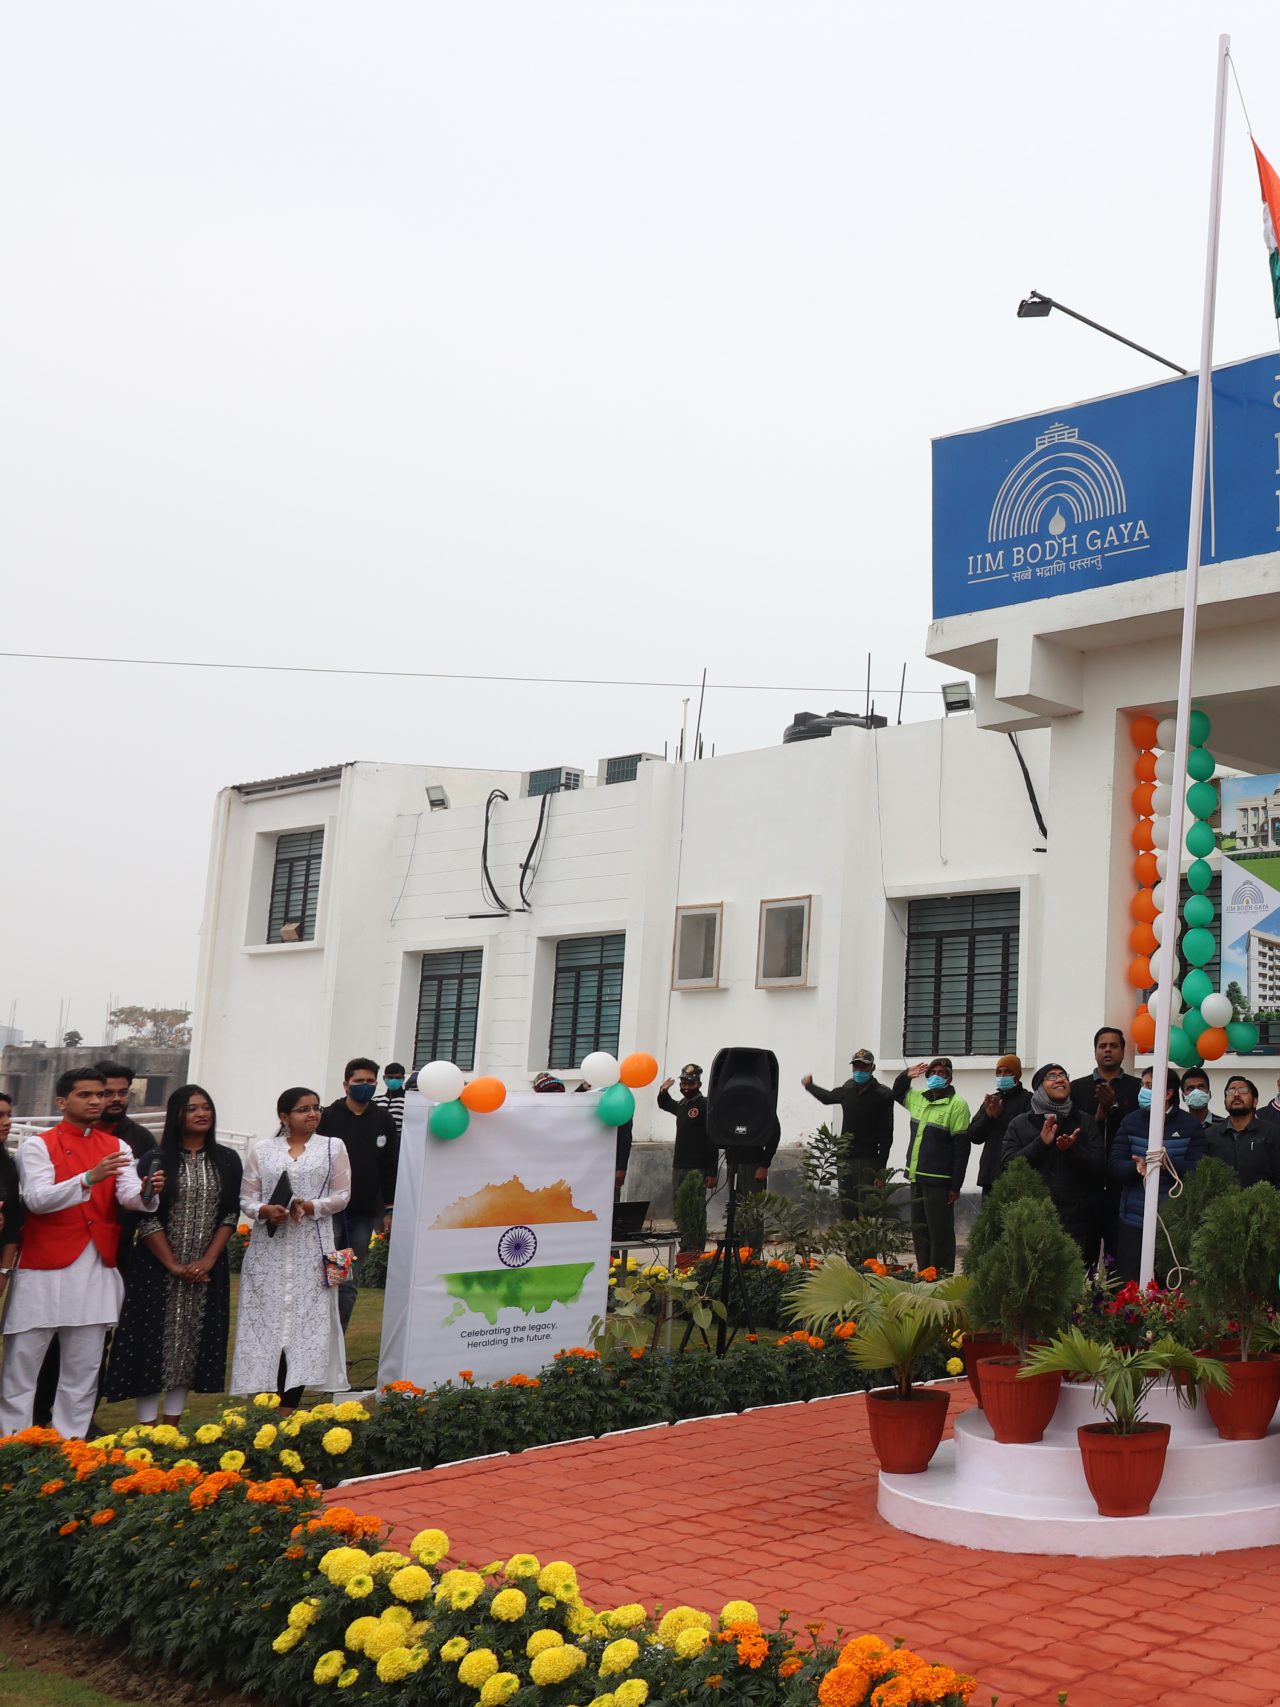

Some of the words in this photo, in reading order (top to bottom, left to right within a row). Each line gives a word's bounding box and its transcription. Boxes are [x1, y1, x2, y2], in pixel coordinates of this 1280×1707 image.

[967, 551, 1005, 576] IIM
[1012, 534, 1078, 567] BODH
[1086, 519, 1150, 551] GAYA
[1035, 560, 1066, 578] भद्राणि
[1069, 554, 1102, 572] पस्सन्तु
[460, 1326, 511, 1339] Celebrating
[513, 1325, 527, 1333] the
[467, 1337, 508, 1349] Heralding
[510, 1335, 525, 1344] the
